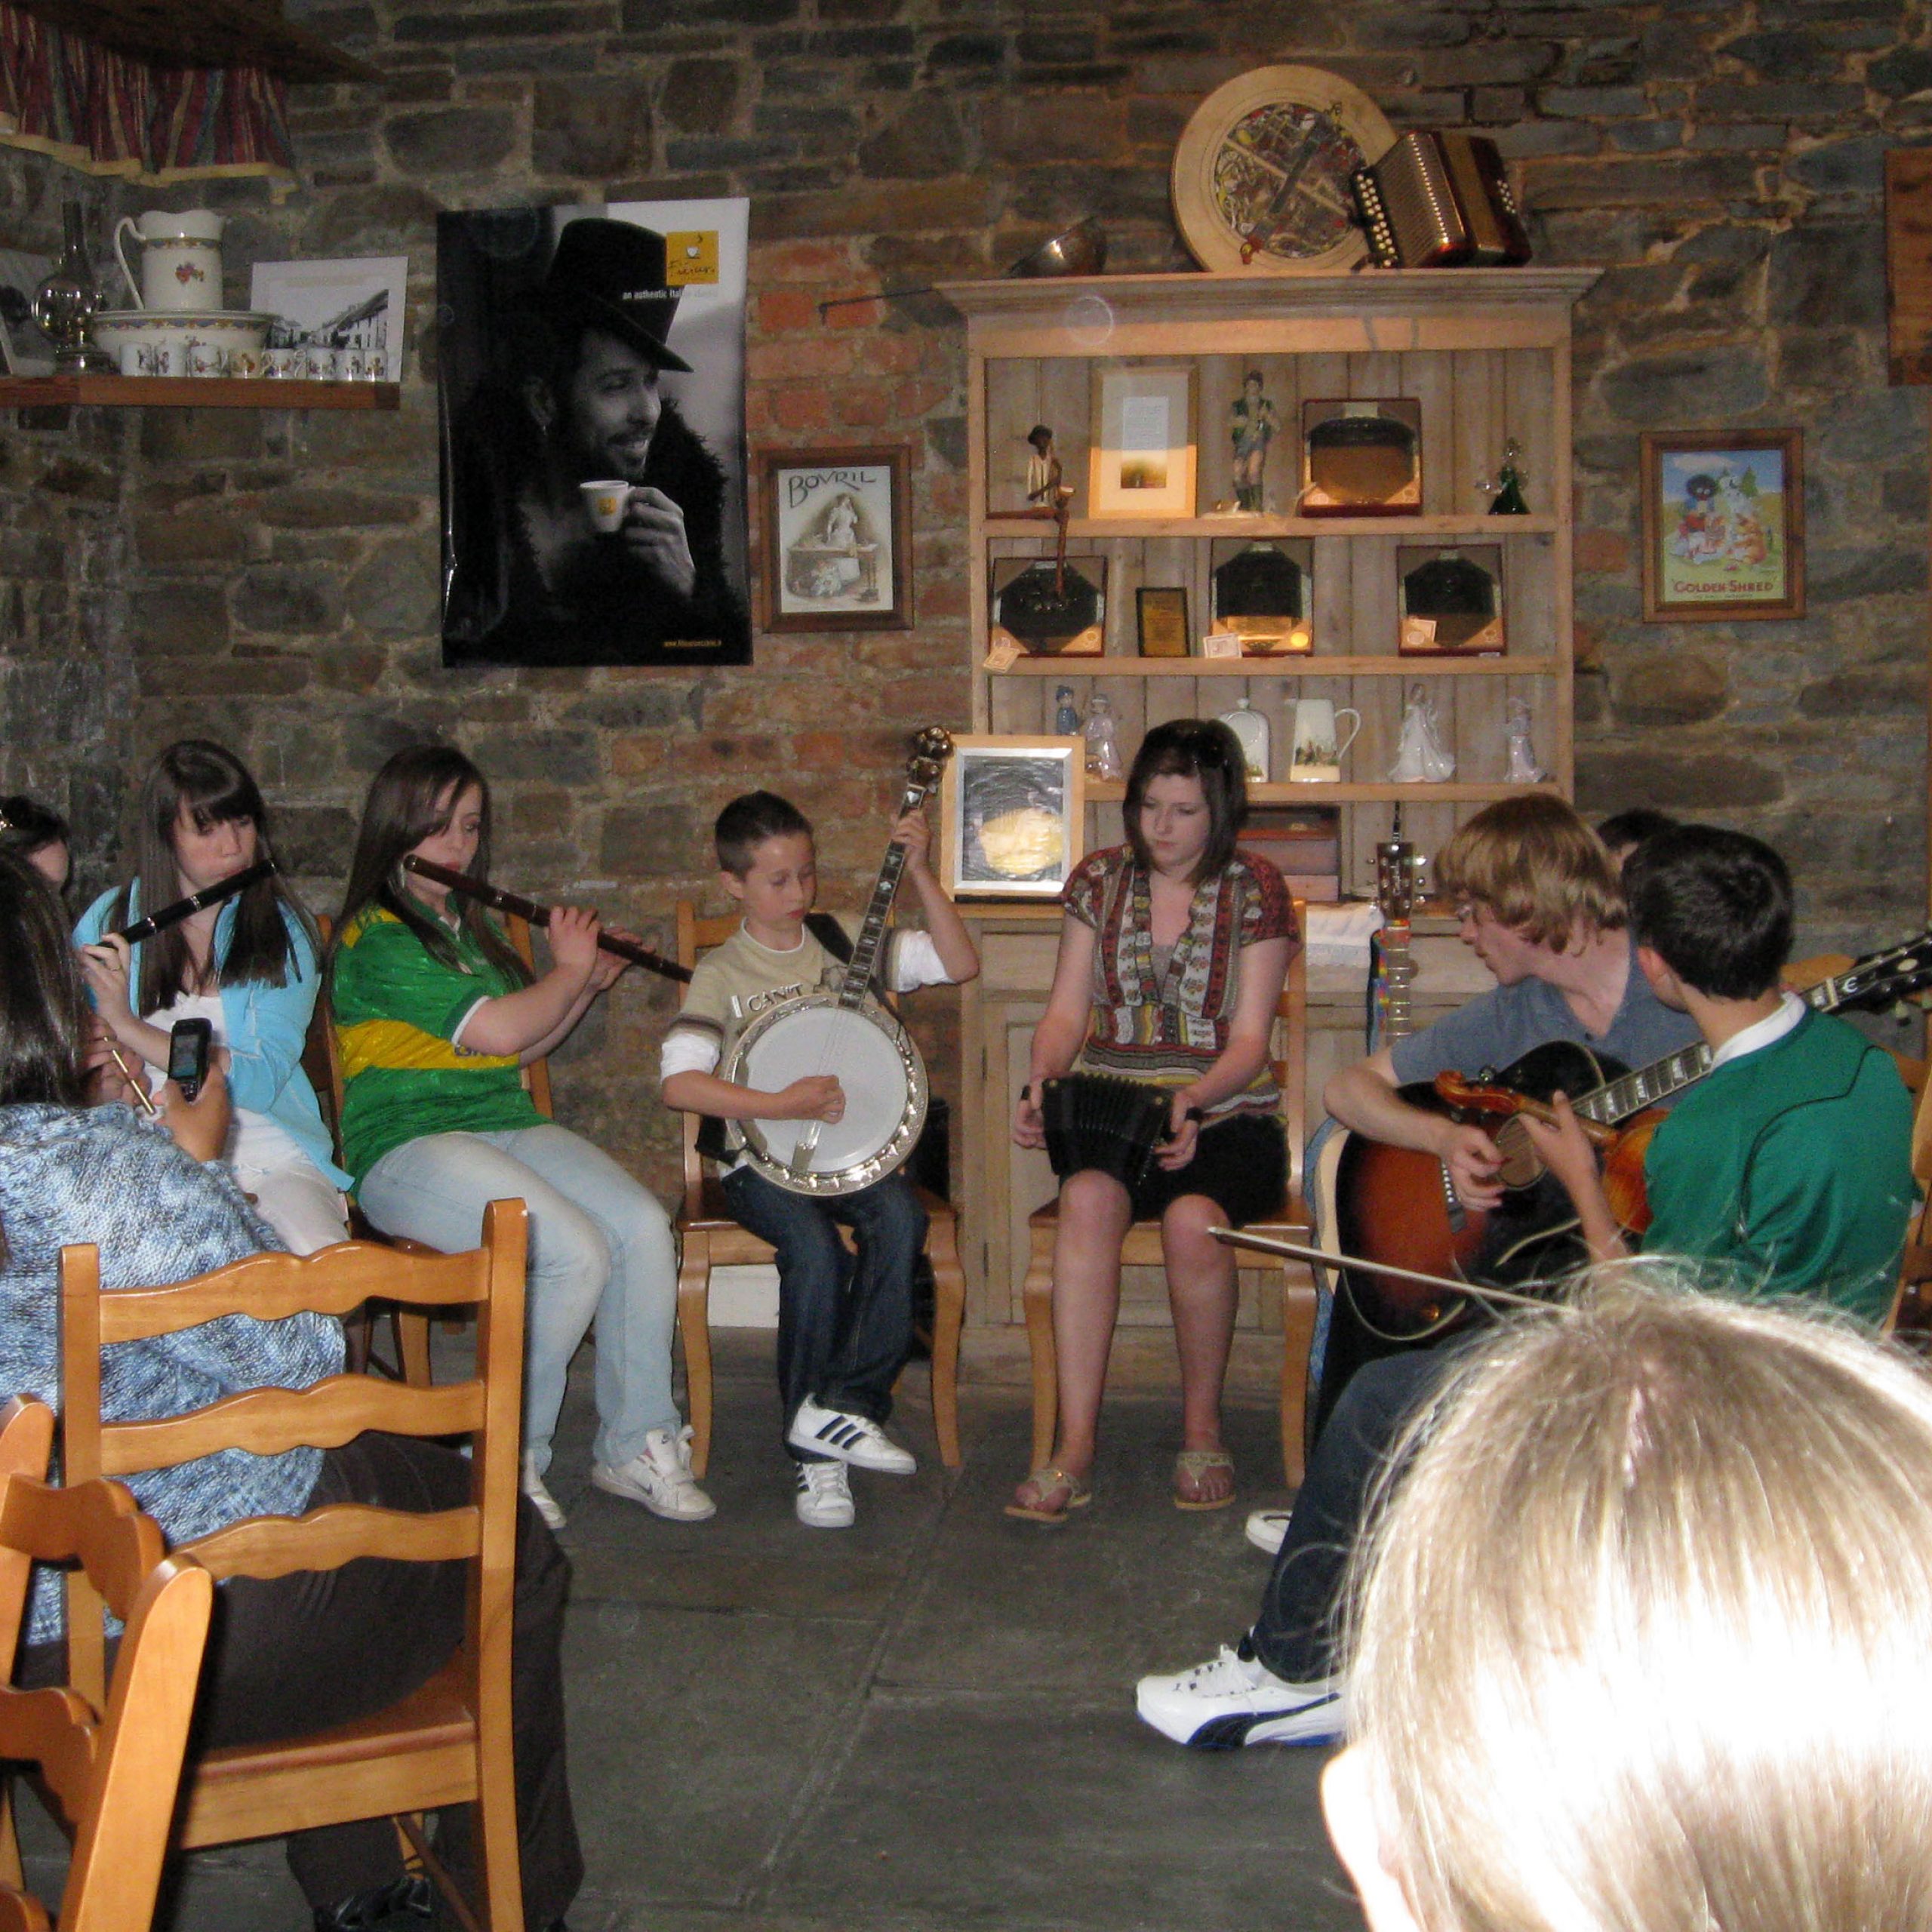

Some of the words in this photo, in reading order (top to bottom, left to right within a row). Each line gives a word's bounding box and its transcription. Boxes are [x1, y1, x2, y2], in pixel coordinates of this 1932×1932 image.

[788, 470, 877, 509] BOVRIL
[731, 995, 743, 1018] I
[747, 983, 803, 1012] CAN'T
